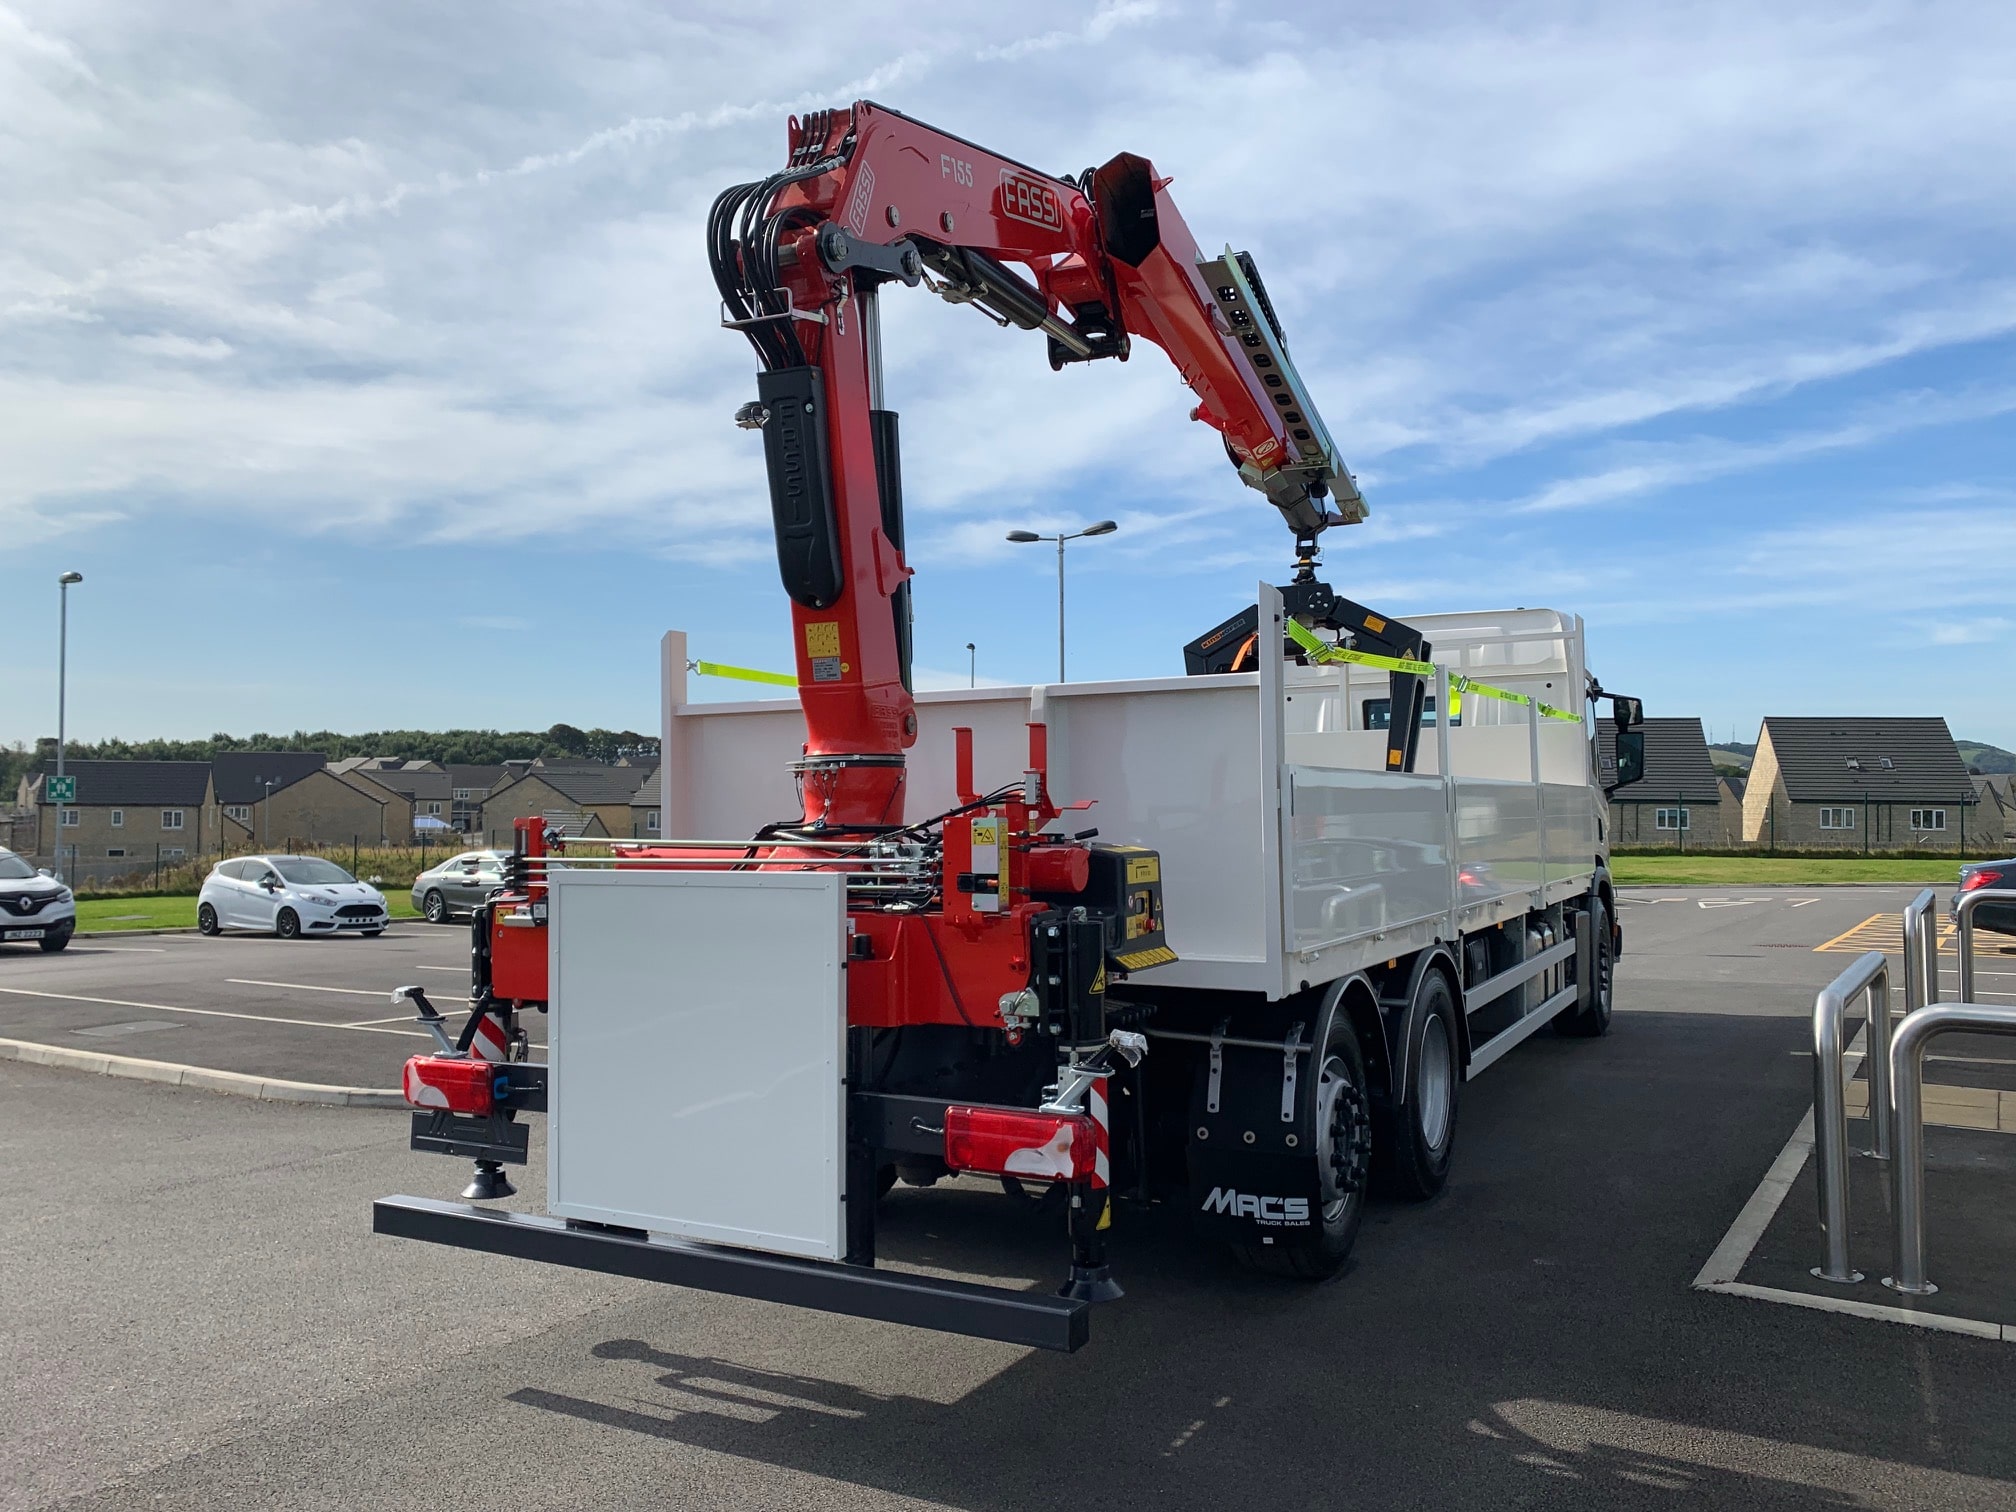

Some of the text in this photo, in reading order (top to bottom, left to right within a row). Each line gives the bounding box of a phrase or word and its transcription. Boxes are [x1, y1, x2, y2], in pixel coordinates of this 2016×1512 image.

[940, 153, 974, 188] F155
[852, 168, 873, 230] FASSI
[1004, 175, 1060, 225] FASSI
[778, 403, 803, 522] FASSI
